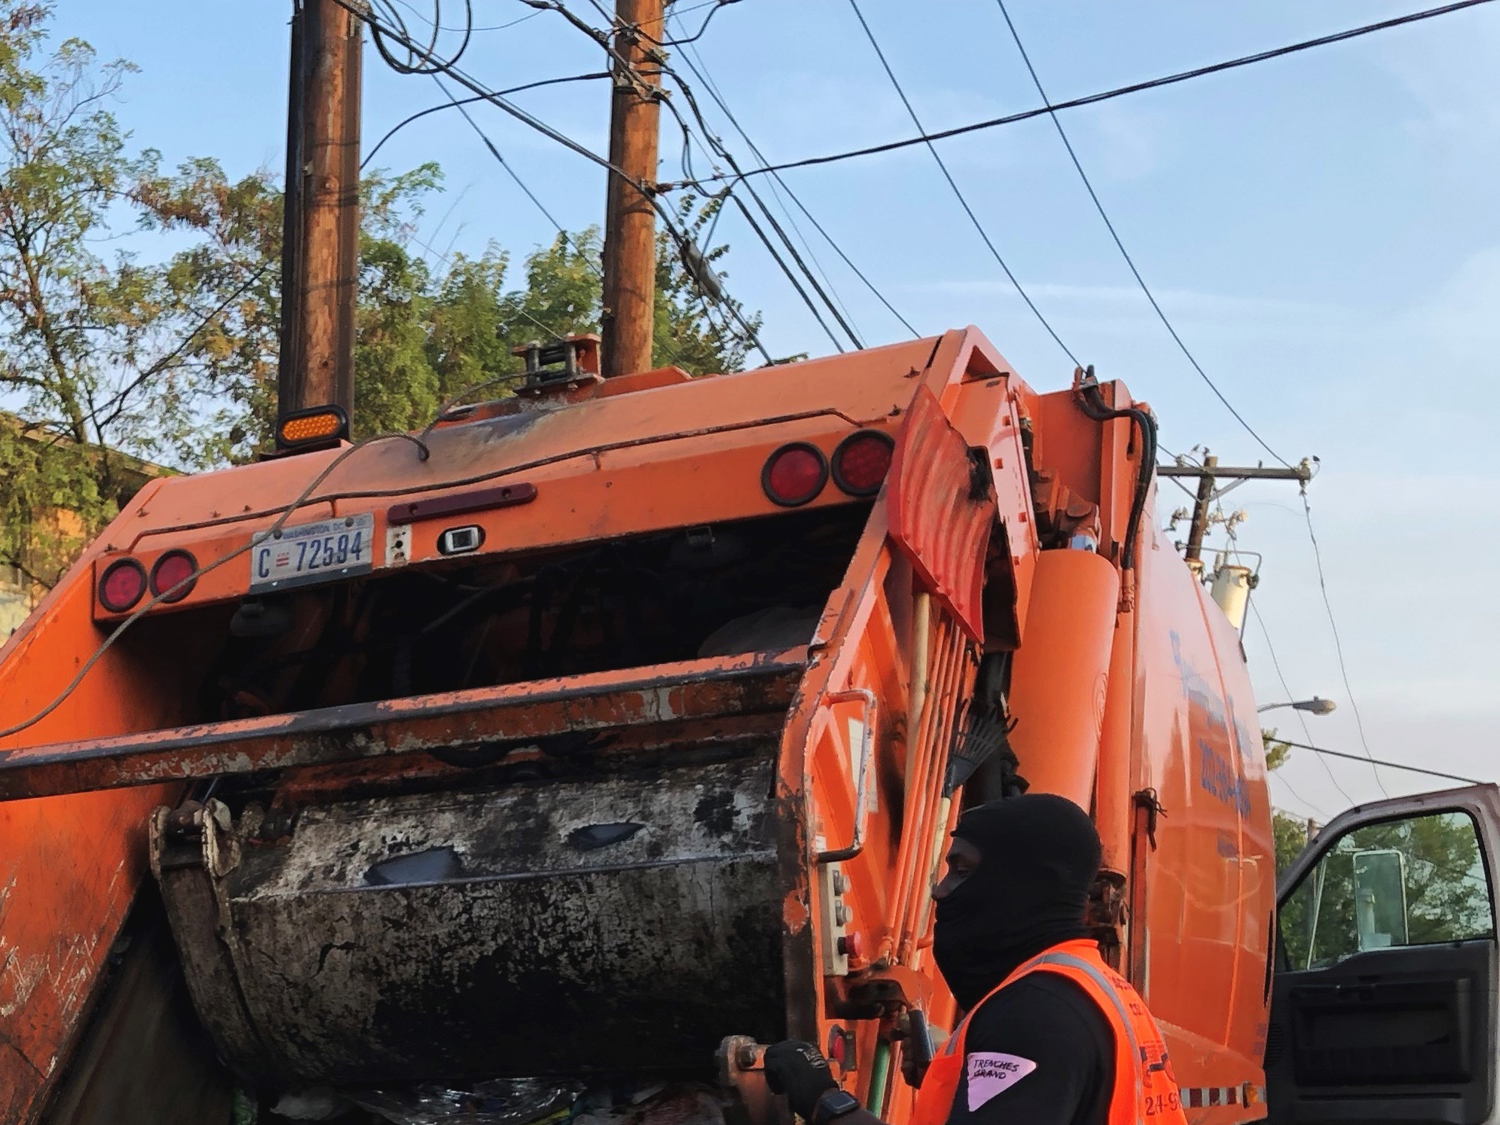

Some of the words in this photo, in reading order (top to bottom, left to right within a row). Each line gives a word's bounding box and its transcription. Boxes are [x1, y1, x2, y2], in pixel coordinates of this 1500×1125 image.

[257, 547, 271, 579] C
[296, 531, 362, 572] 72594
[973, 1058, 1020, 1073] TRENCHES
